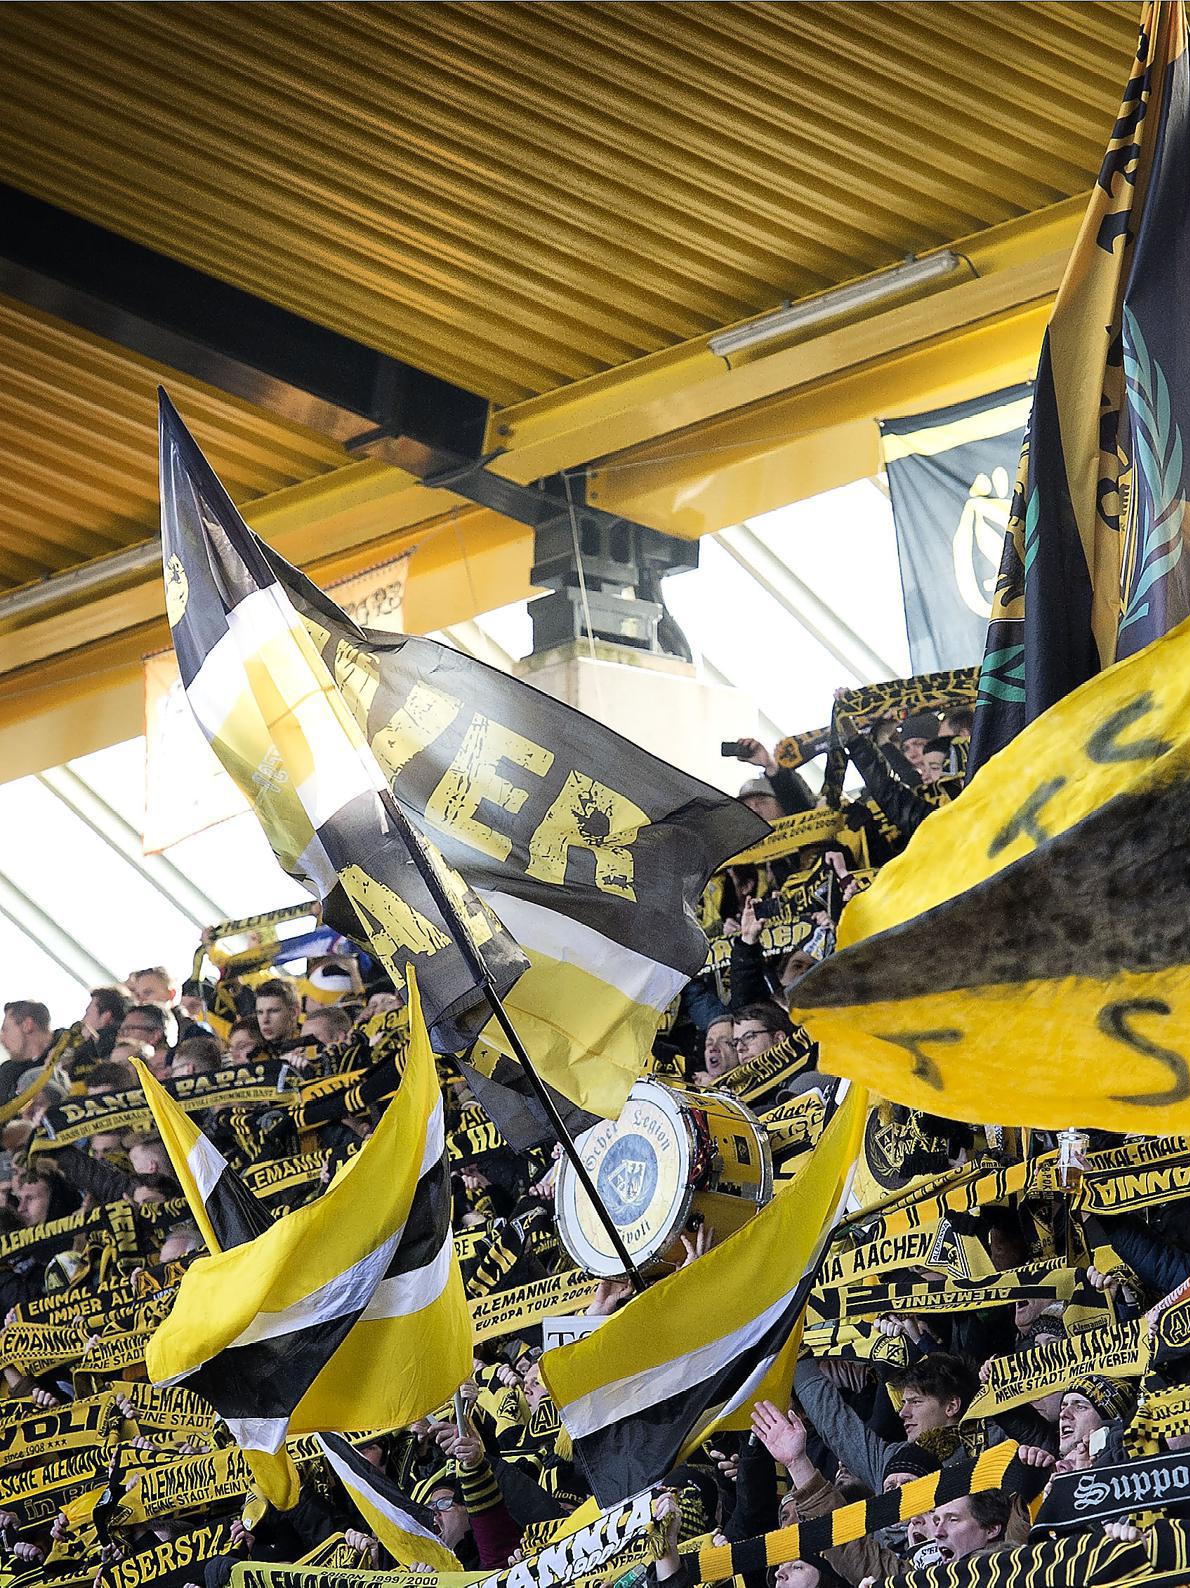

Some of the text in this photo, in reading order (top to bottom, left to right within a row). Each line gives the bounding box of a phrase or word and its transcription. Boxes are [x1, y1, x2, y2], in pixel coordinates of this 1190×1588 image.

[852, 1232, 935, 1274] AACHEN
[28, 1286, 93, 1317] EINMAL
[49, 1297, 103, 1326] IMMER
[471, 1276, 562, 1321] ALEMANNIA
[475, 1307, 527, 1332] EUROPA
[526, 1295, 561, 1319] TOUR
[890, 1287, 1012, 1310] ALEMANNIA
[990, 1326, 1142, 1391] ALEMANNIA AACHEN
[994, 1349, 1141, 1405] MEINE STADT, MEIN VEREIN
[25, 1441, 47, 1458] 1908
[139, 1455, 217, 1504] ALEMANNIA
[143, 1481, 242, 1517] MEINE STADT, MEIN
